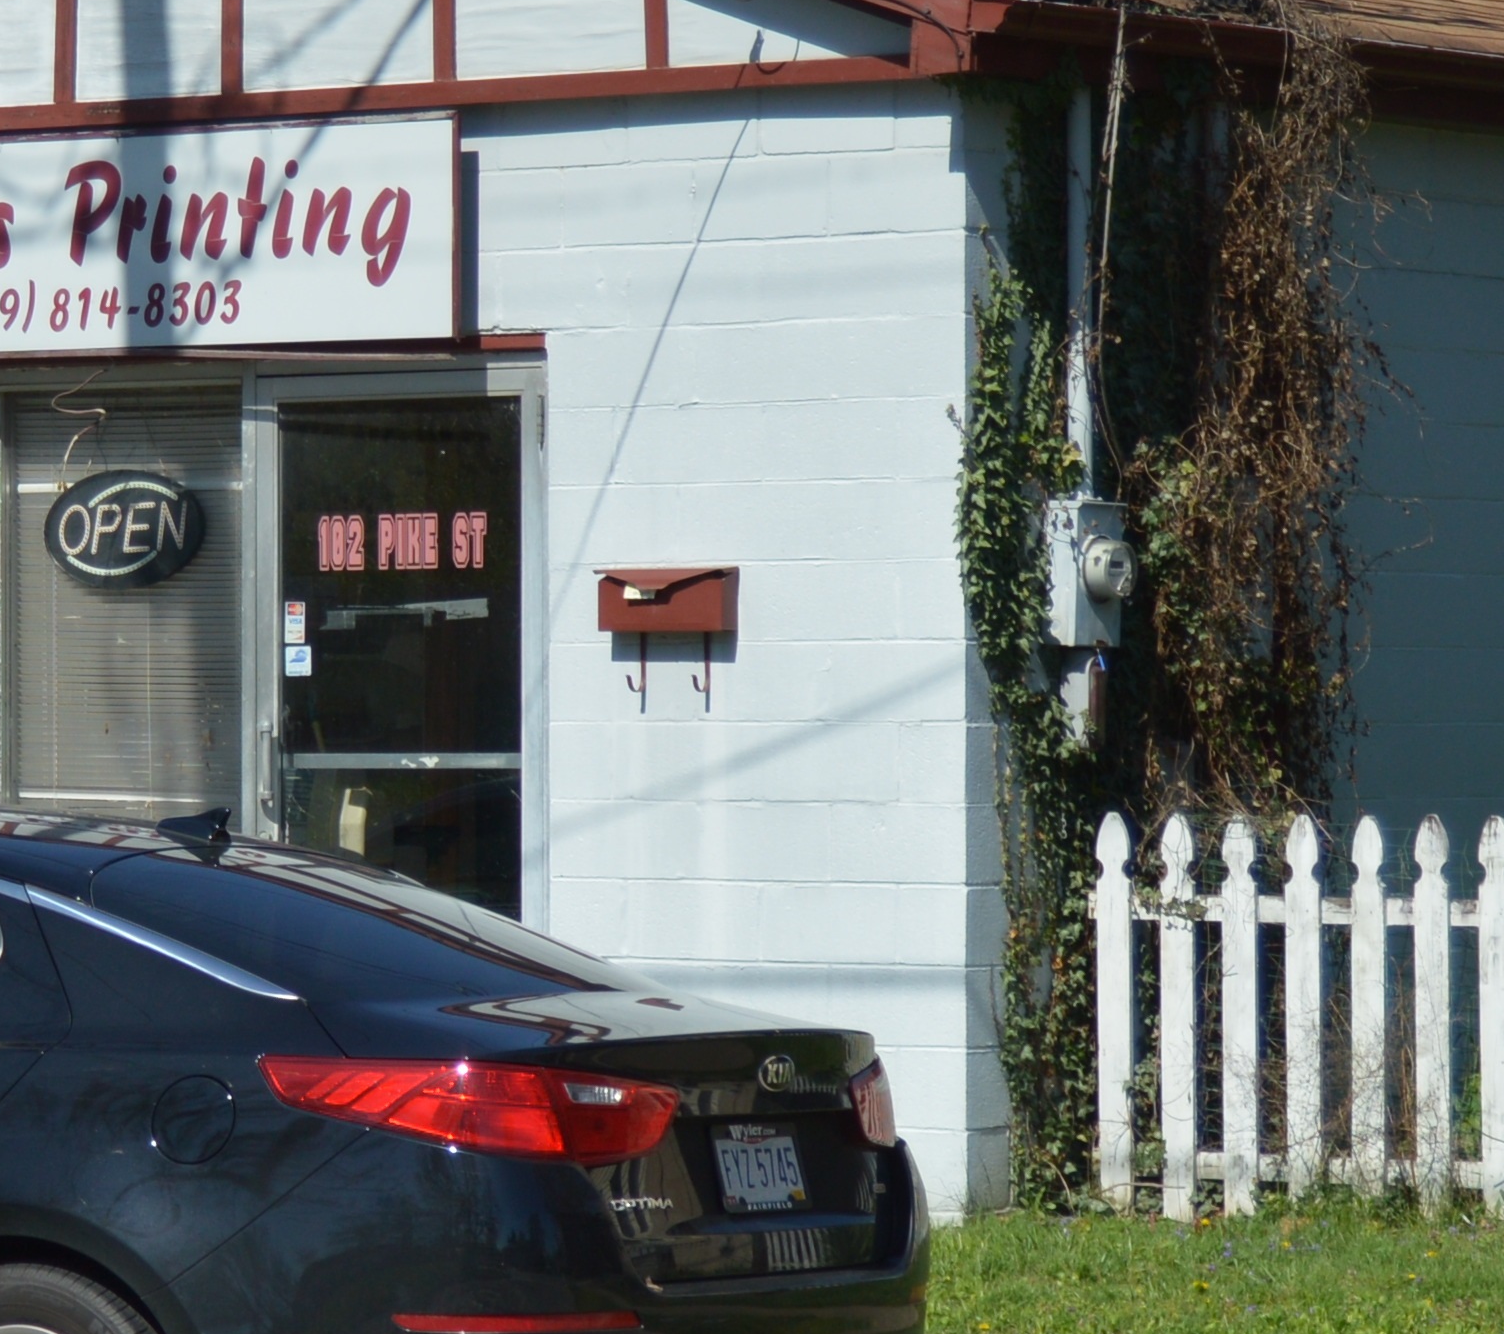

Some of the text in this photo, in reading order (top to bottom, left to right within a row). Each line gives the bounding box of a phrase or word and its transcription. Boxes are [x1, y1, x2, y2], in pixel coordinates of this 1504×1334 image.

[65, 156, 413, 288] Printing
[48, 279, 244, 333] 814-8303
[58, 500, 188, 557] OPEN
[318, 511, 488, 572] 102 PIKE ST
[767, 1062, 792, 1084] KIA
[721, 1146, 799, 1190] FYZ 5745
[610, 1197, 674, 1211] OPTIMA
